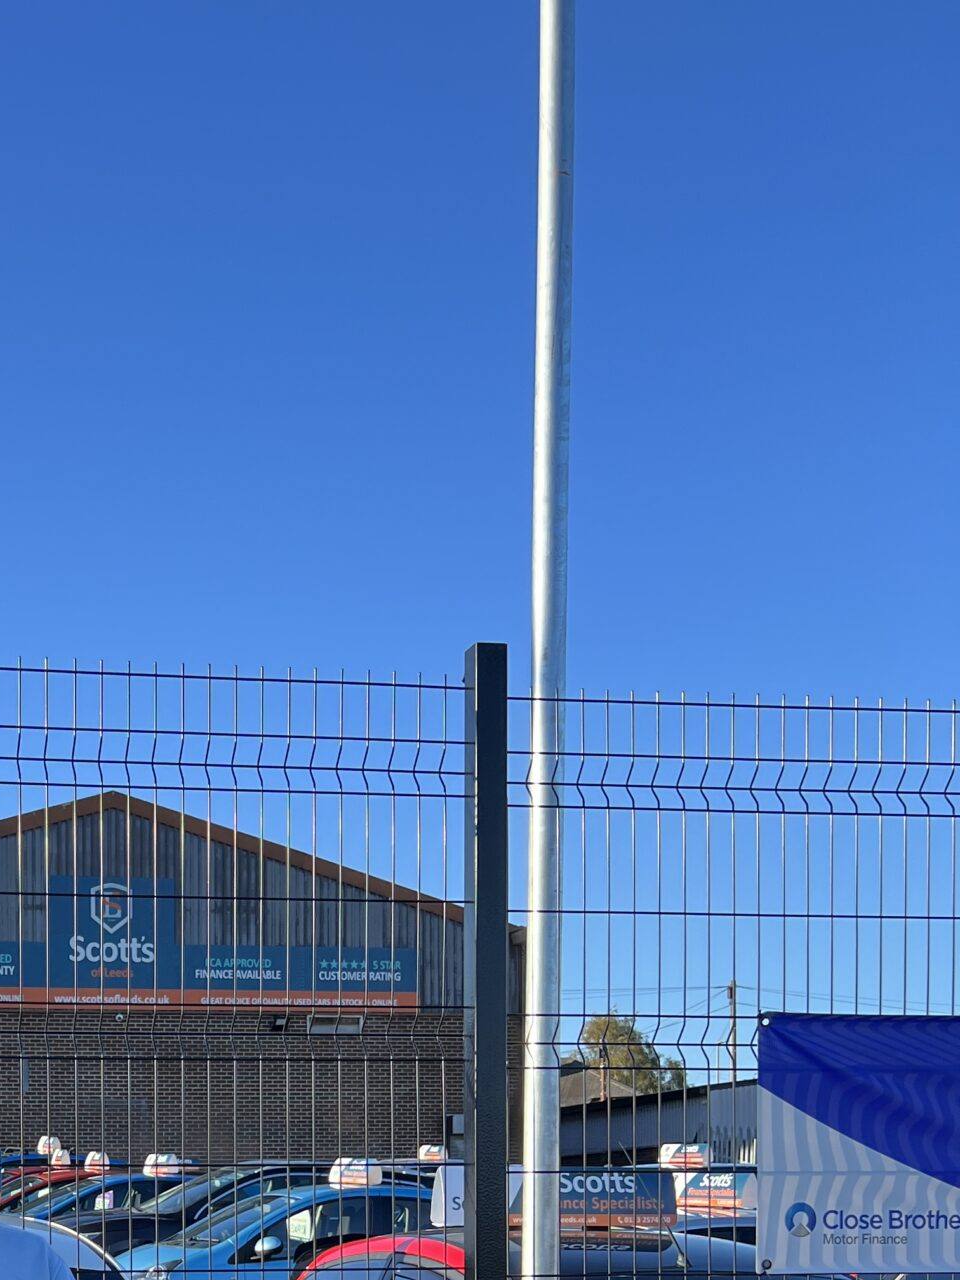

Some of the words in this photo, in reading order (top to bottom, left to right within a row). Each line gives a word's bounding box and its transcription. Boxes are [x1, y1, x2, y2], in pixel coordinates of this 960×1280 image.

[69, 936, 155, 963] Scott's
[195, 969, 233, 979] FINANCE
[236, 970, 281, 980] AVAILABLE
[319, 971, 367, 981] CUSTOMER
[369, 972, 401, 982] RATING
[54, 994, 170, 1004] www.scotsofleeds.co.uk
[200, 997, 223, 1005] GEAT
[592, 1196, 665, 1212] Specialists
[624, 1216, 641, 1224] 013
[823, 1210, 883, 1229] Close
[889, 1210, 960, 1229] Brothe
[823, 1234, 858, 1245] Motor
[862, 1234, 908, 1245] Finance
